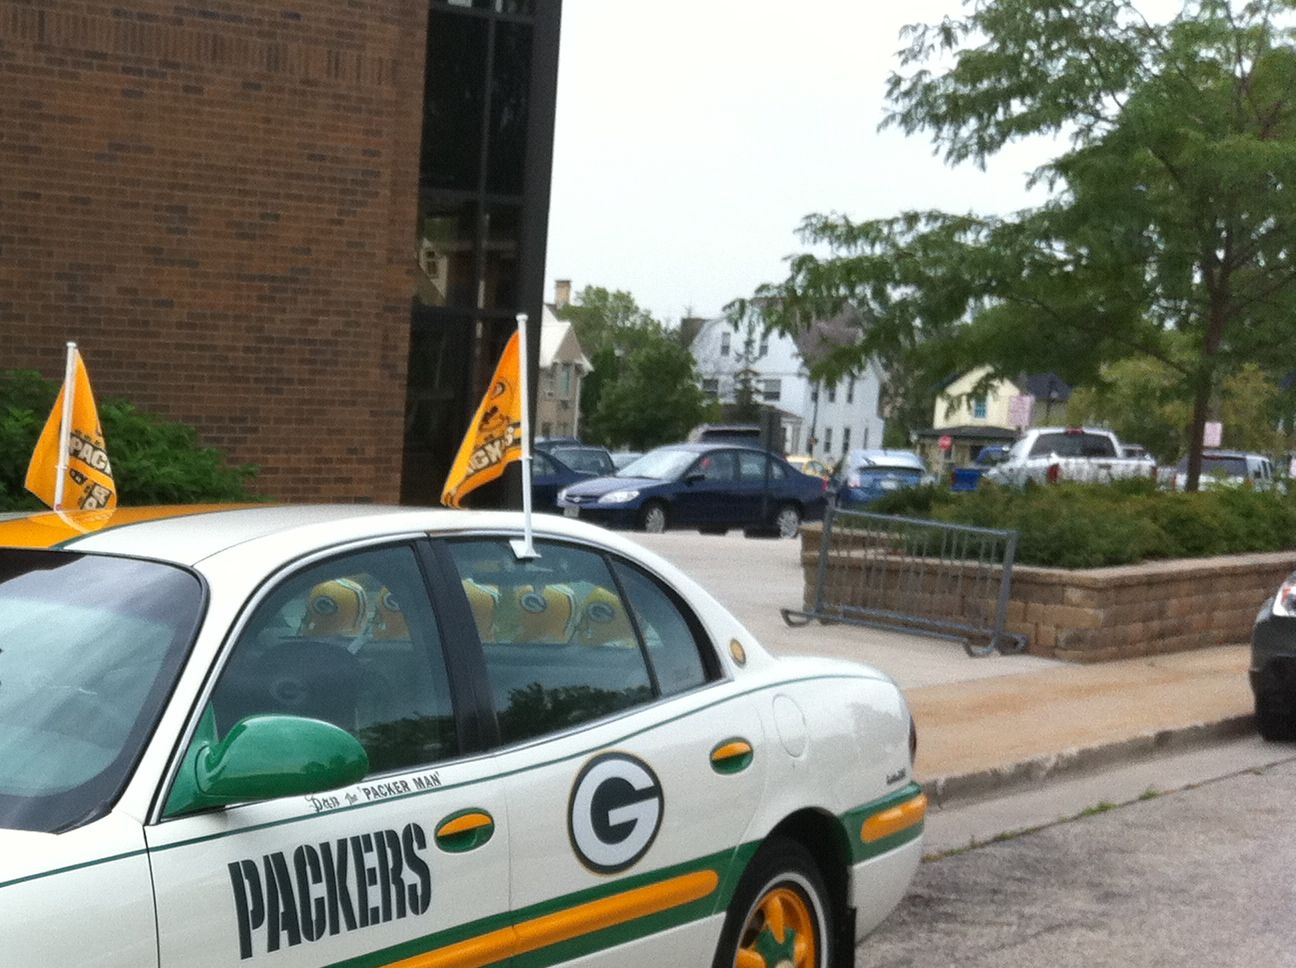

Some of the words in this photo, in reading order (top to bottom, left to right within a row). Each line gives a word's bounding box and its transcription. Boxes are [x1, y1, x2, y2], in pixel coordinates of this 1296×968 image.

[305, 792, 340, 813] Dan
[571, 759, 660, 867] G
[228, 823, 431, 960] PACKERS
